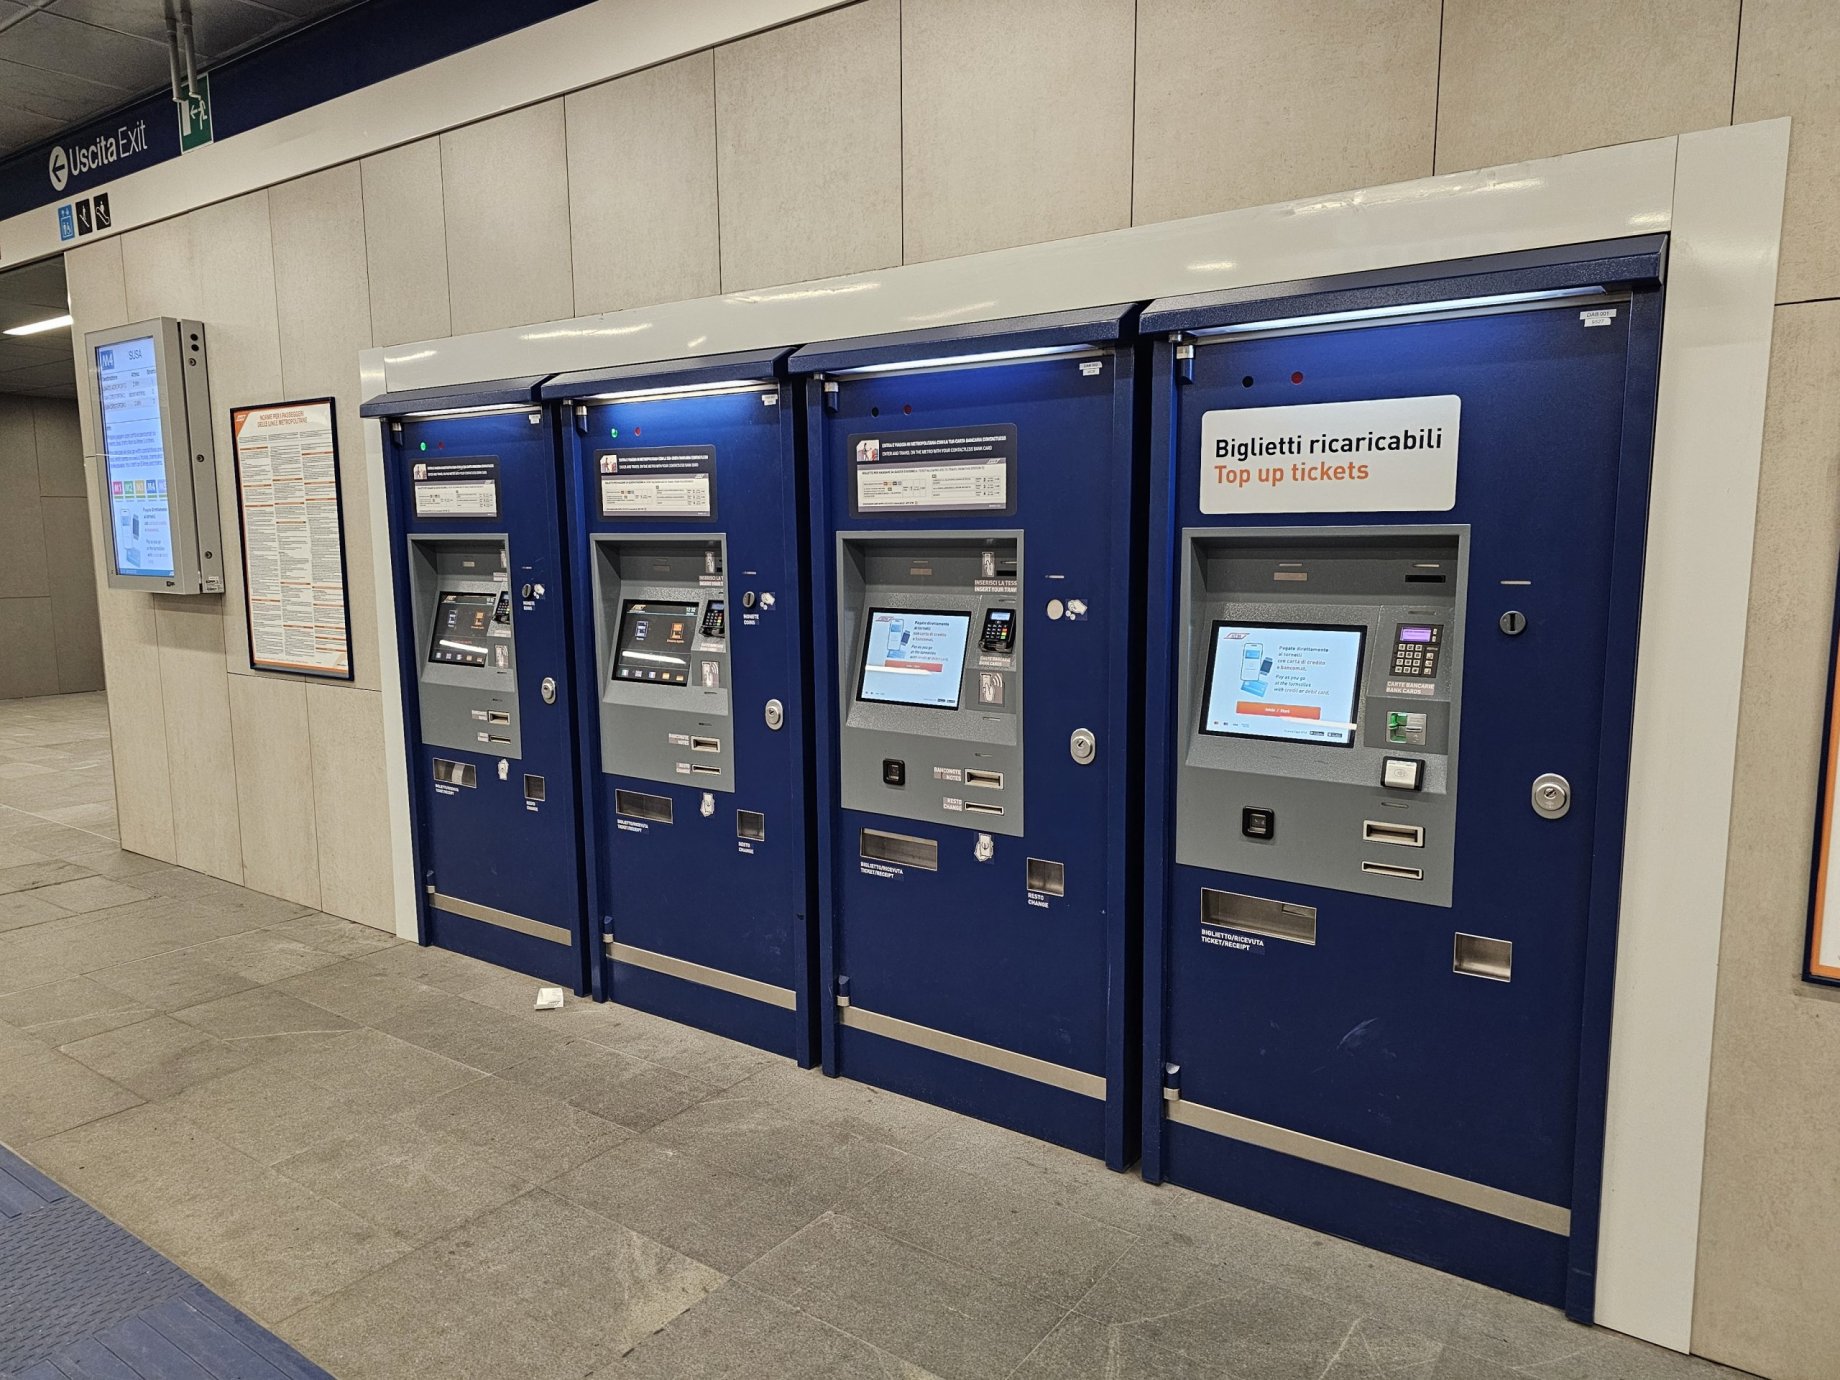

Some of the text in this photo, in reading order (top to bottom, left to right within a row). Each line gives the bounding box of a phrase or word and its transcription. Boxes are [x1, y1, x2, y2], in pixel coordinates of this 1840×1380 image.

[69, 120, 148, 176] Uscita Exit
[1215, 428, 1442, 462] Biglietti ricaricabili
[1214, 461, 1369, 488] Top up tickets
[1028, 892, 1044, 901] RESTO
[1028, 899, 1049, 908] CHANGE
[1201, 929, 1264, 946] BIGLIETTO/RICEVUTA
[1201, 936, 1250, 951] TICKET/RECEIPT
